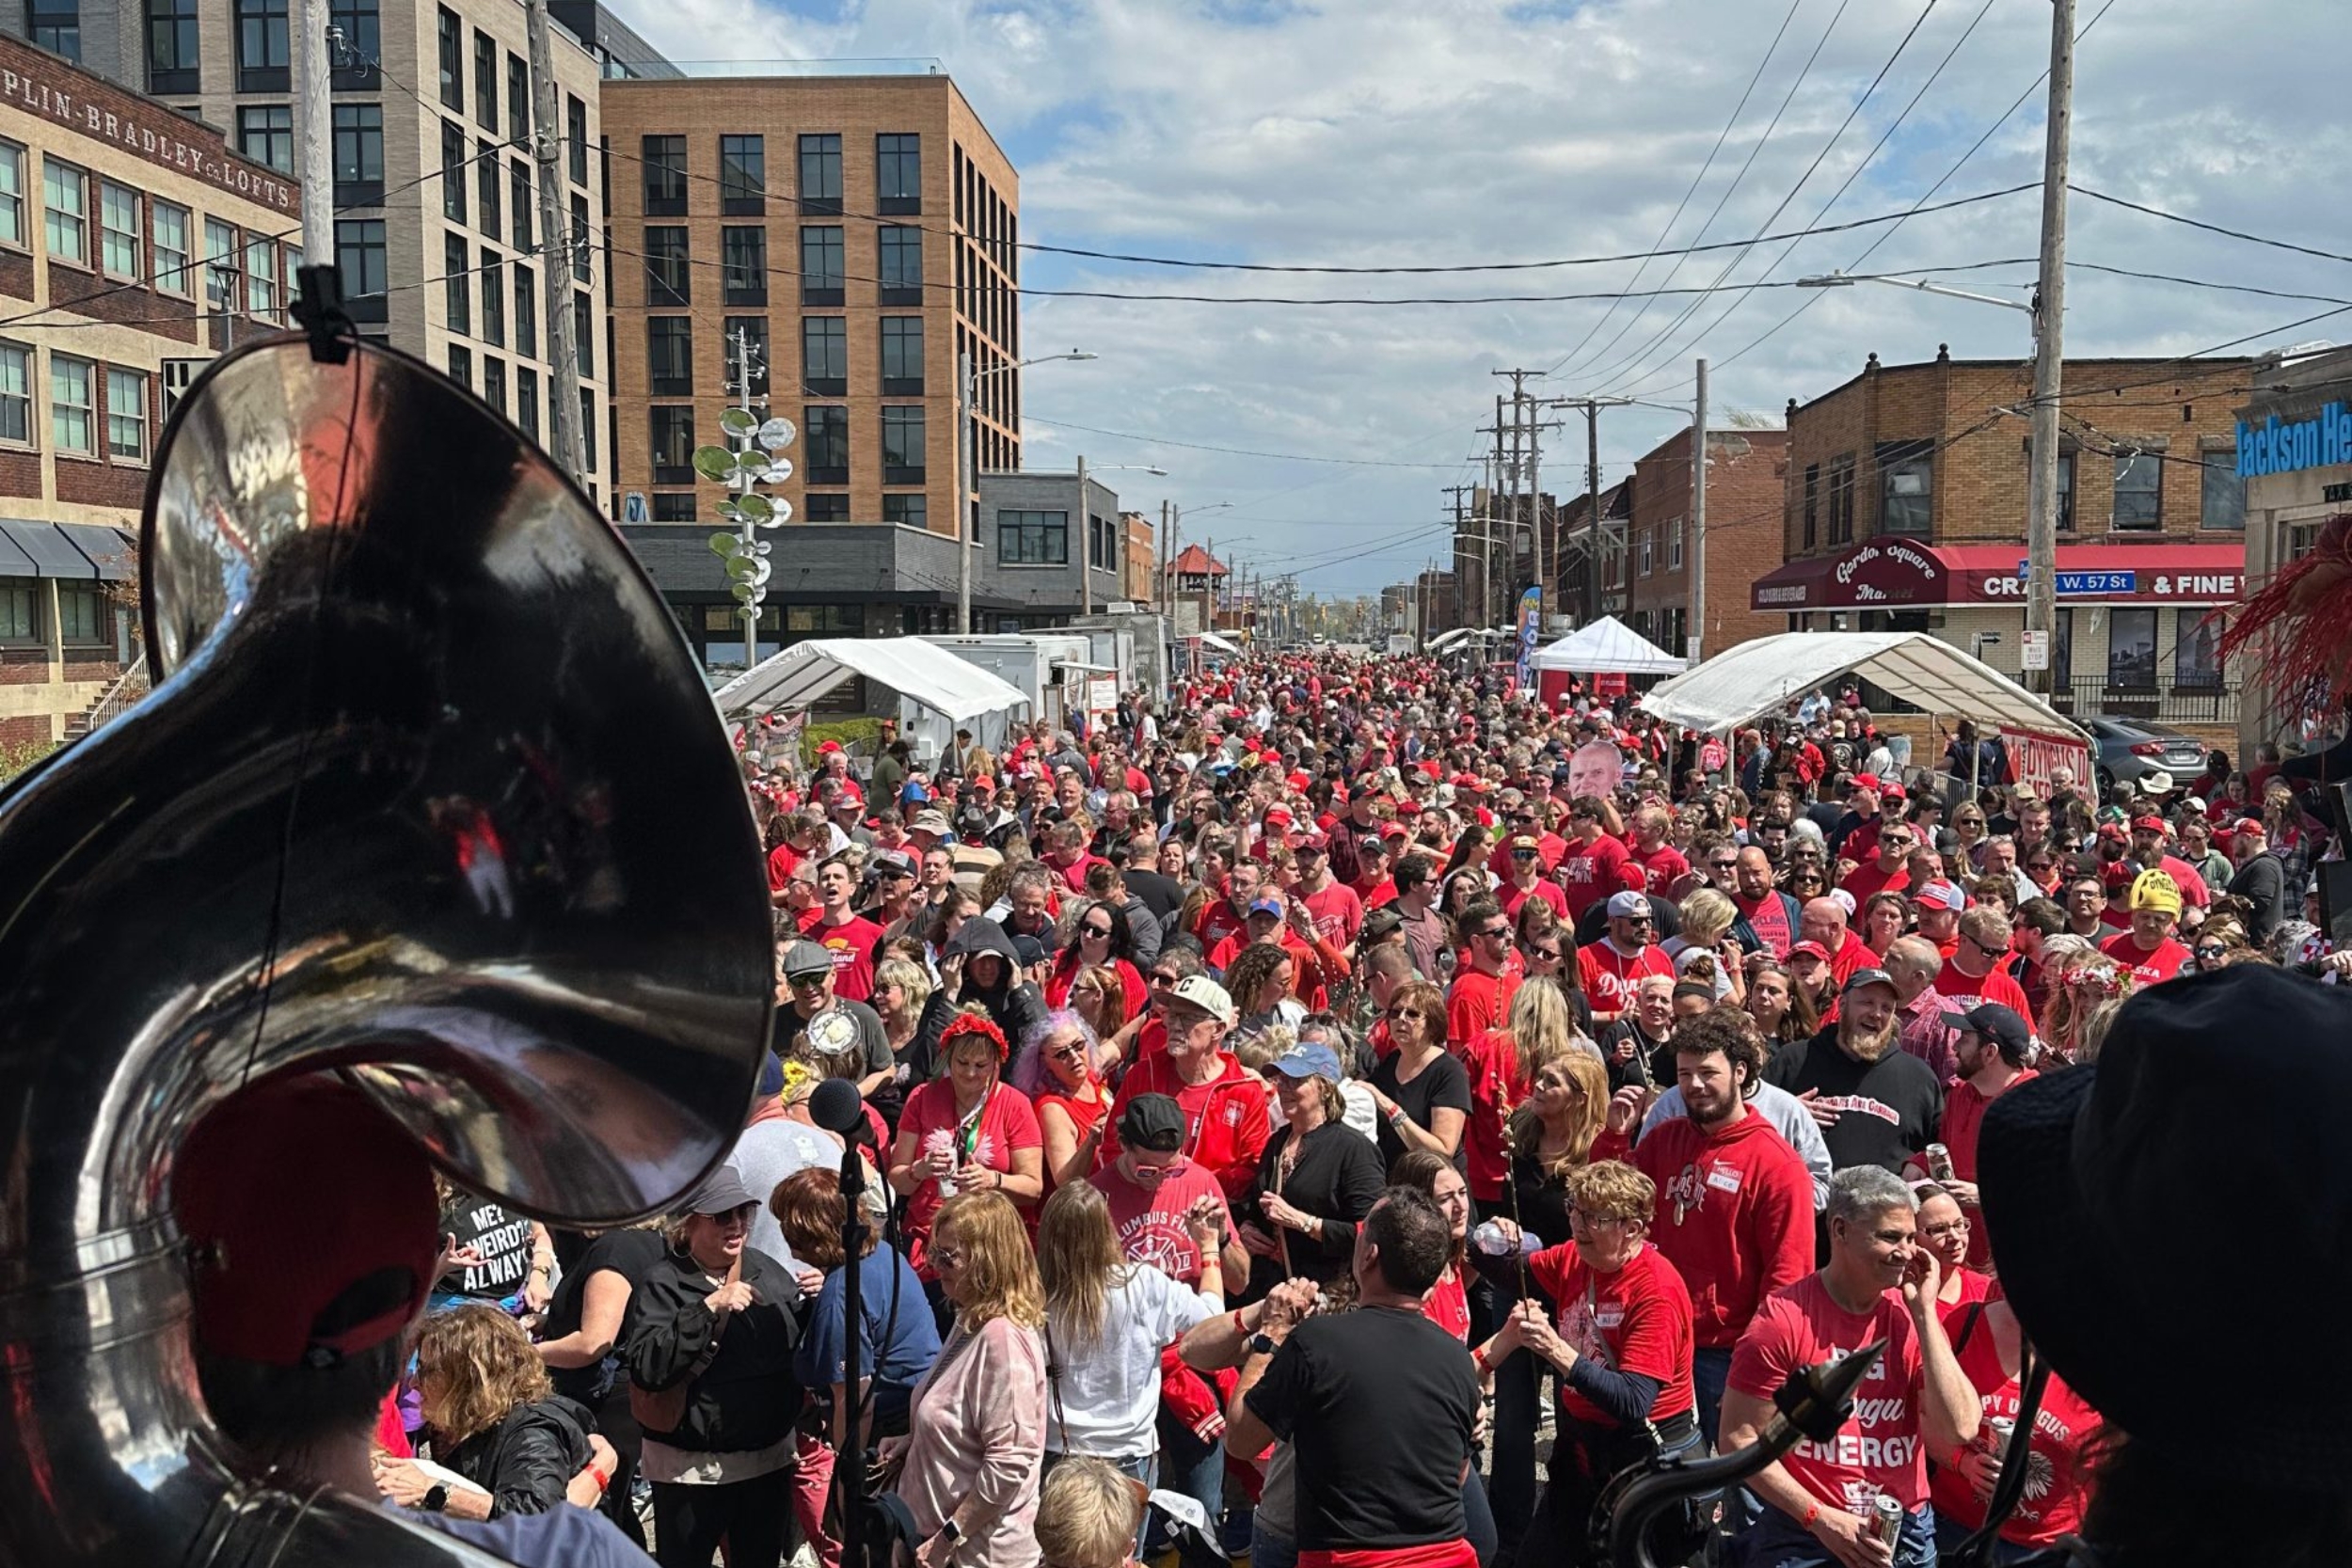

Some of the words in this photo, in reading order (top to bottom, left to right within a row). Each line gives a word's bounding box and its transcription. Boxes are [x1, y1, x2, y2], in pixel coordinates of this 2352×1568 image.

[224, 162, 289, 207] LOFTS
[2234, 415, 2319, 478] Jackson
[2063, 577, 2084, 590] W.
[2088, 576, 2106, 589] 57
[2110, 575, 2127, 589] St
[2153, 576, 2172, 594] &
[2177, 576, 2235, 594] FINE
[1179, 978, 1194, 992] C
[2135, 965, 2160, 979] SKA
[470, 1204, 505, 1231] ME?
[466, 1220, 526, 1259] WEIRD?
[464, 1250, 524, 1291] ALWAY
[1794, 1433, 1918, 1468] ENERGY
